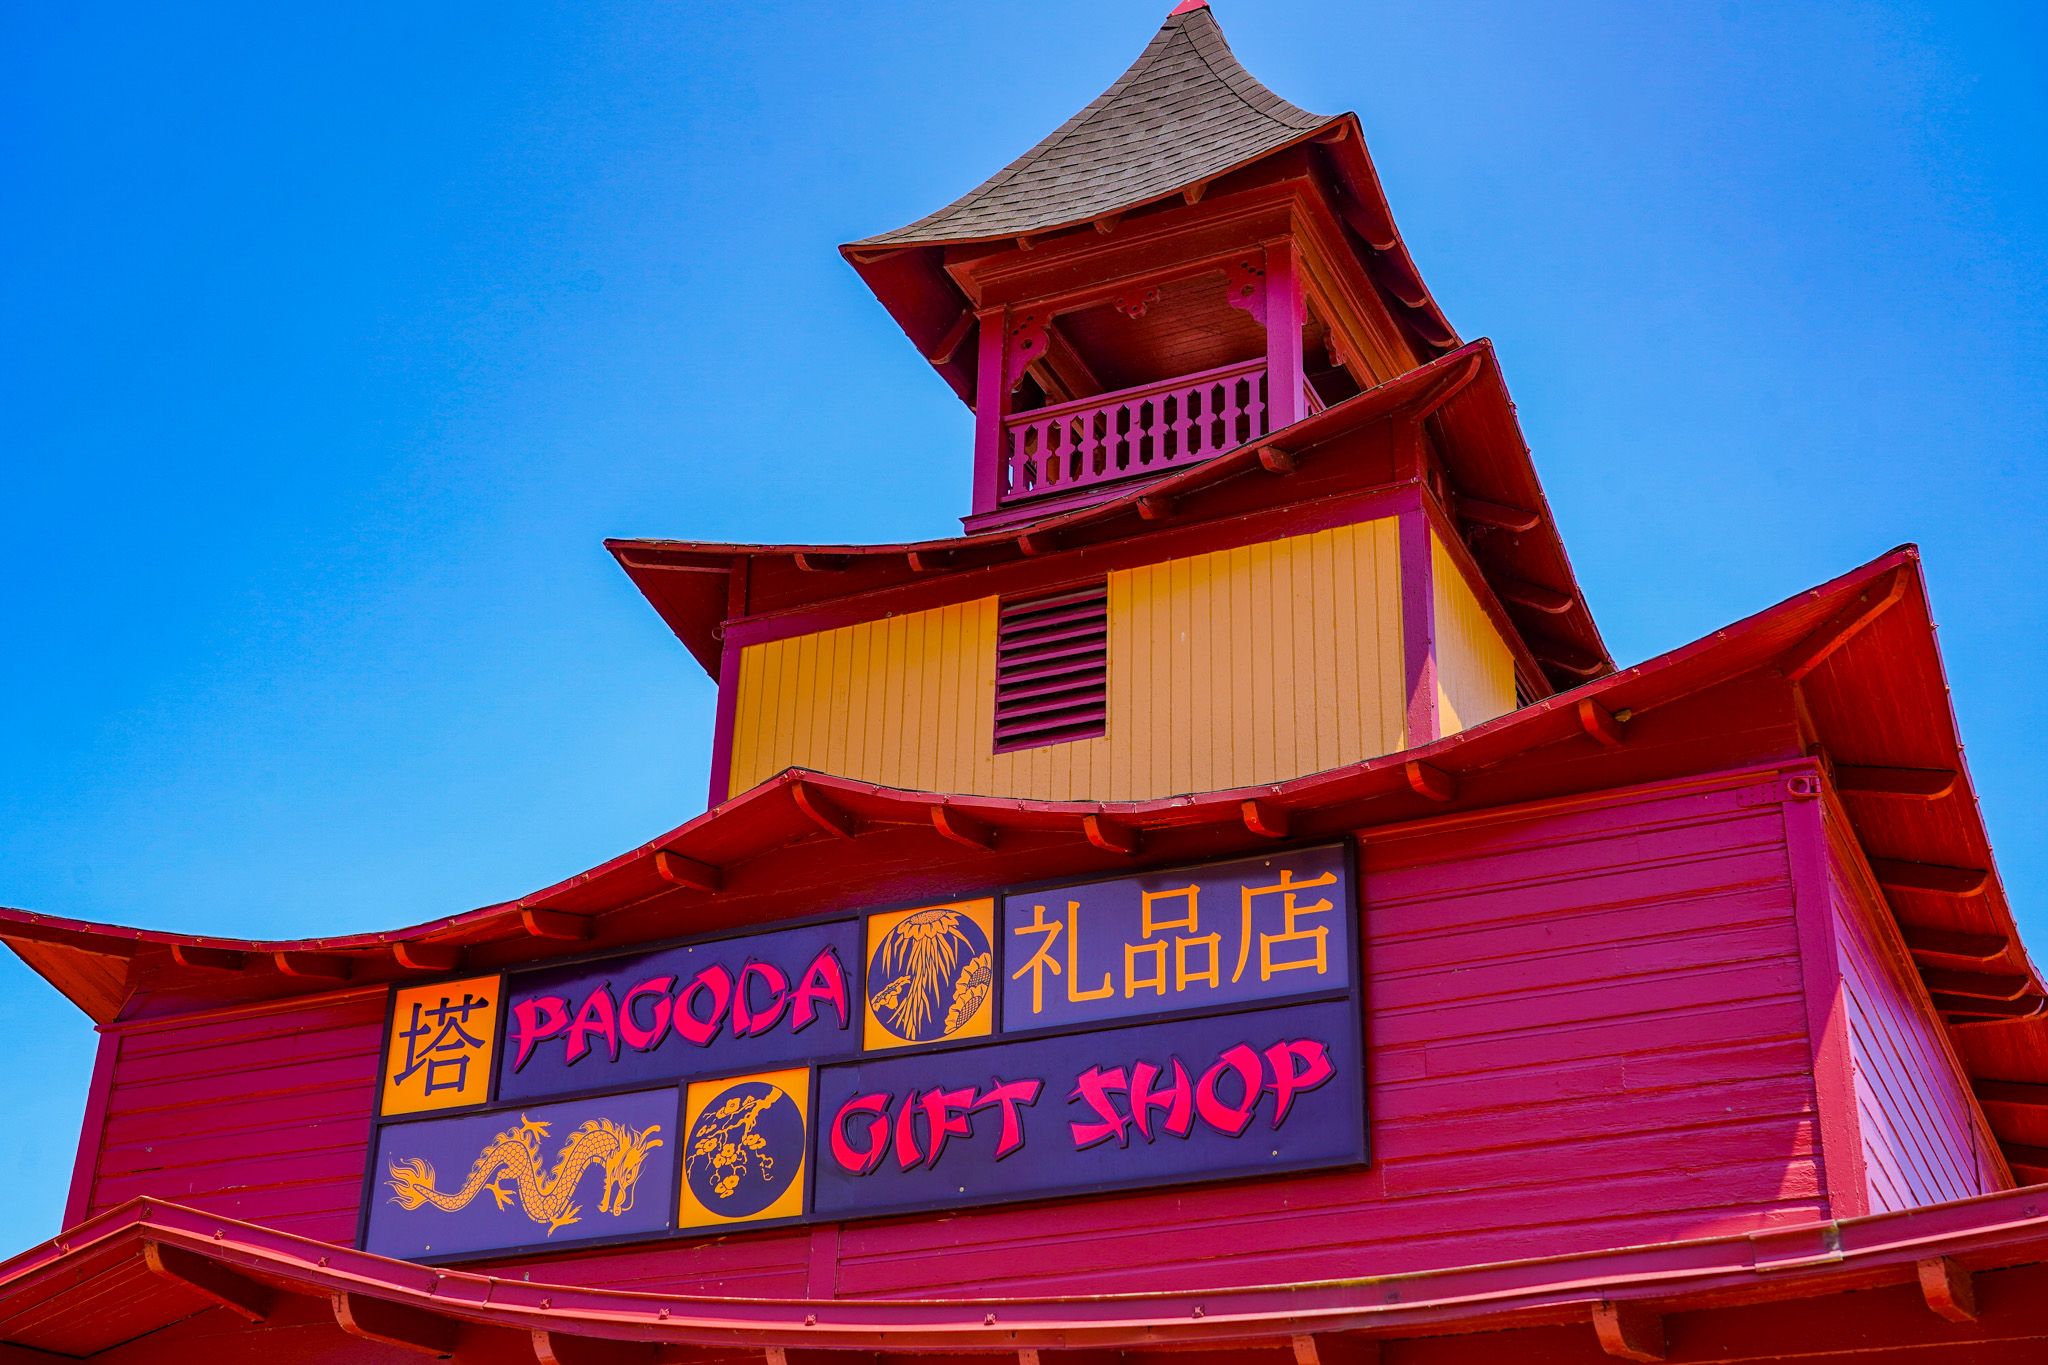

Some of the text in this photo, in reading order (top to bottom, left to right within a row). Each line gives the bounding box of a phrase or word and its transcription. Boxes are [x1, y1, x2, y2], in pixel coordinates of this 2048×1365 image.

[1011, 869, 1339, 1014] 礼品店
[393, 996, 490, 1093] 塔
[511, 945, 849, 1069] PAGODA
[830, 1039, 1334, 1172] GIFT SHOP
